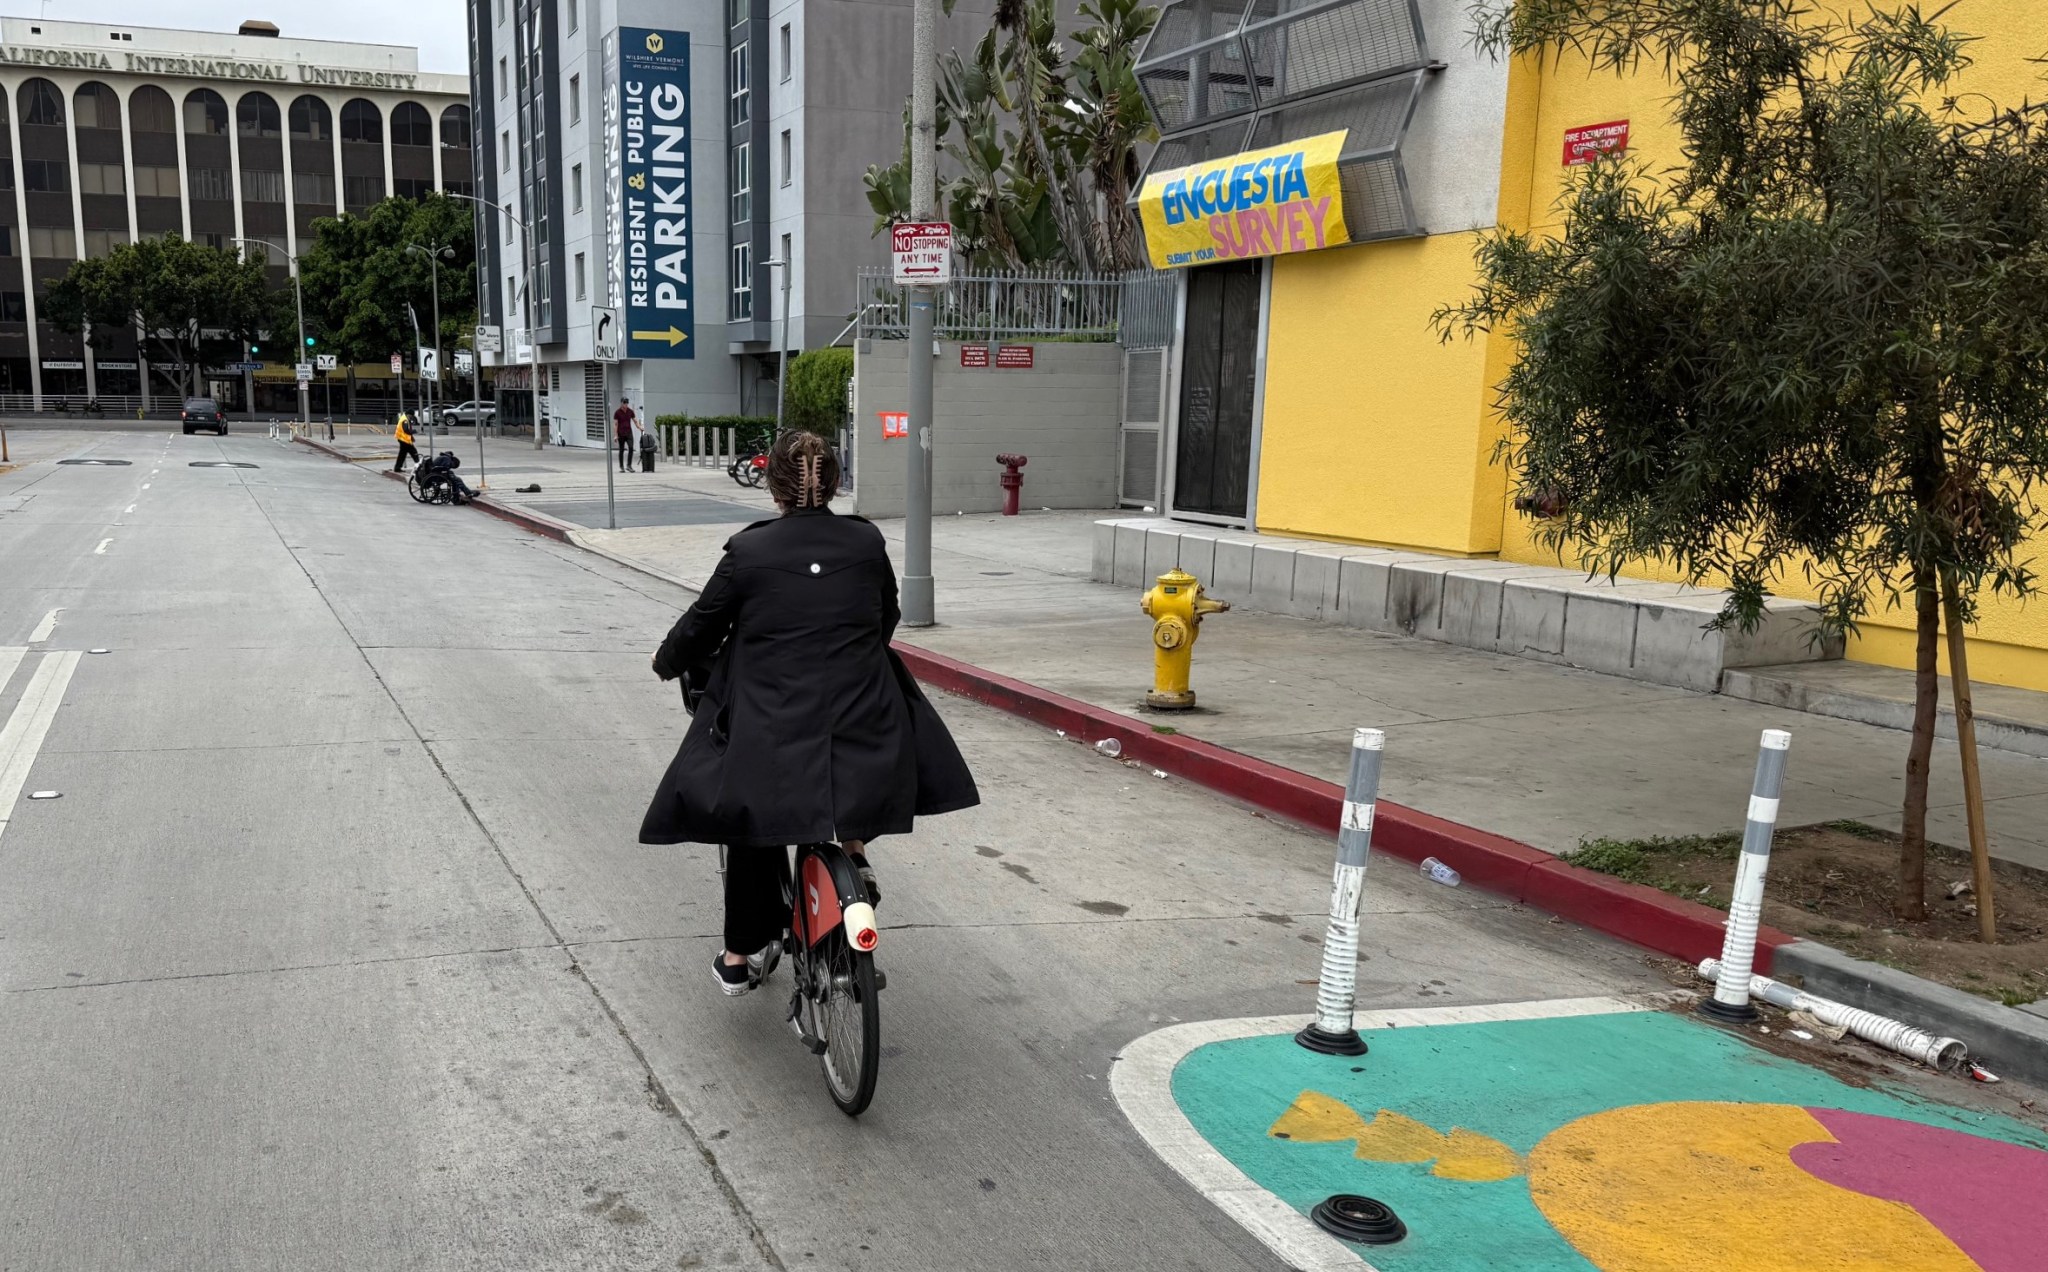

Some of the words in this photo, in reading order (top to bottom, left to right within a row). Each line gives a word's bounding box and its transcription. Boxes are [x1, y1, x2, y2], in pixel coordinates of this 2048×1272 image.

[625, 54, 653, 62] WILSHIRE
[125, 53, 287, 81] INTERNATIONAL
[298, 65, 417, 89] UNIVERSITY
[625, 81, 645, 163] PUBLIC
[1565, 132, 1580, 143] FIRE
[1581, 125, 1628, 140] DEPARTMENT
[628, 172, 645, 190] &
[1162, 151, 1310, 226] ENCUESTA
[609, 83, 622, 307] PARKING
[650, 83, 688, 309] PARKING
[1209, 196, 1331, 259] SURVEY
[628, 197, 648, 307] RESIDENT
[894, 236, 911, 251] NO
[913, 238, 949, 249] STOPPING
[901, 253, 919, 264] ANY
[922, 253, 943, 263] TIME
[1166, 251, 1192, 265] SUBMIT
[1194, 248, 1216, 260] YOUR
[596, 345, 616, 358] ONLY
[421, 370, 436, 379] ONLY
